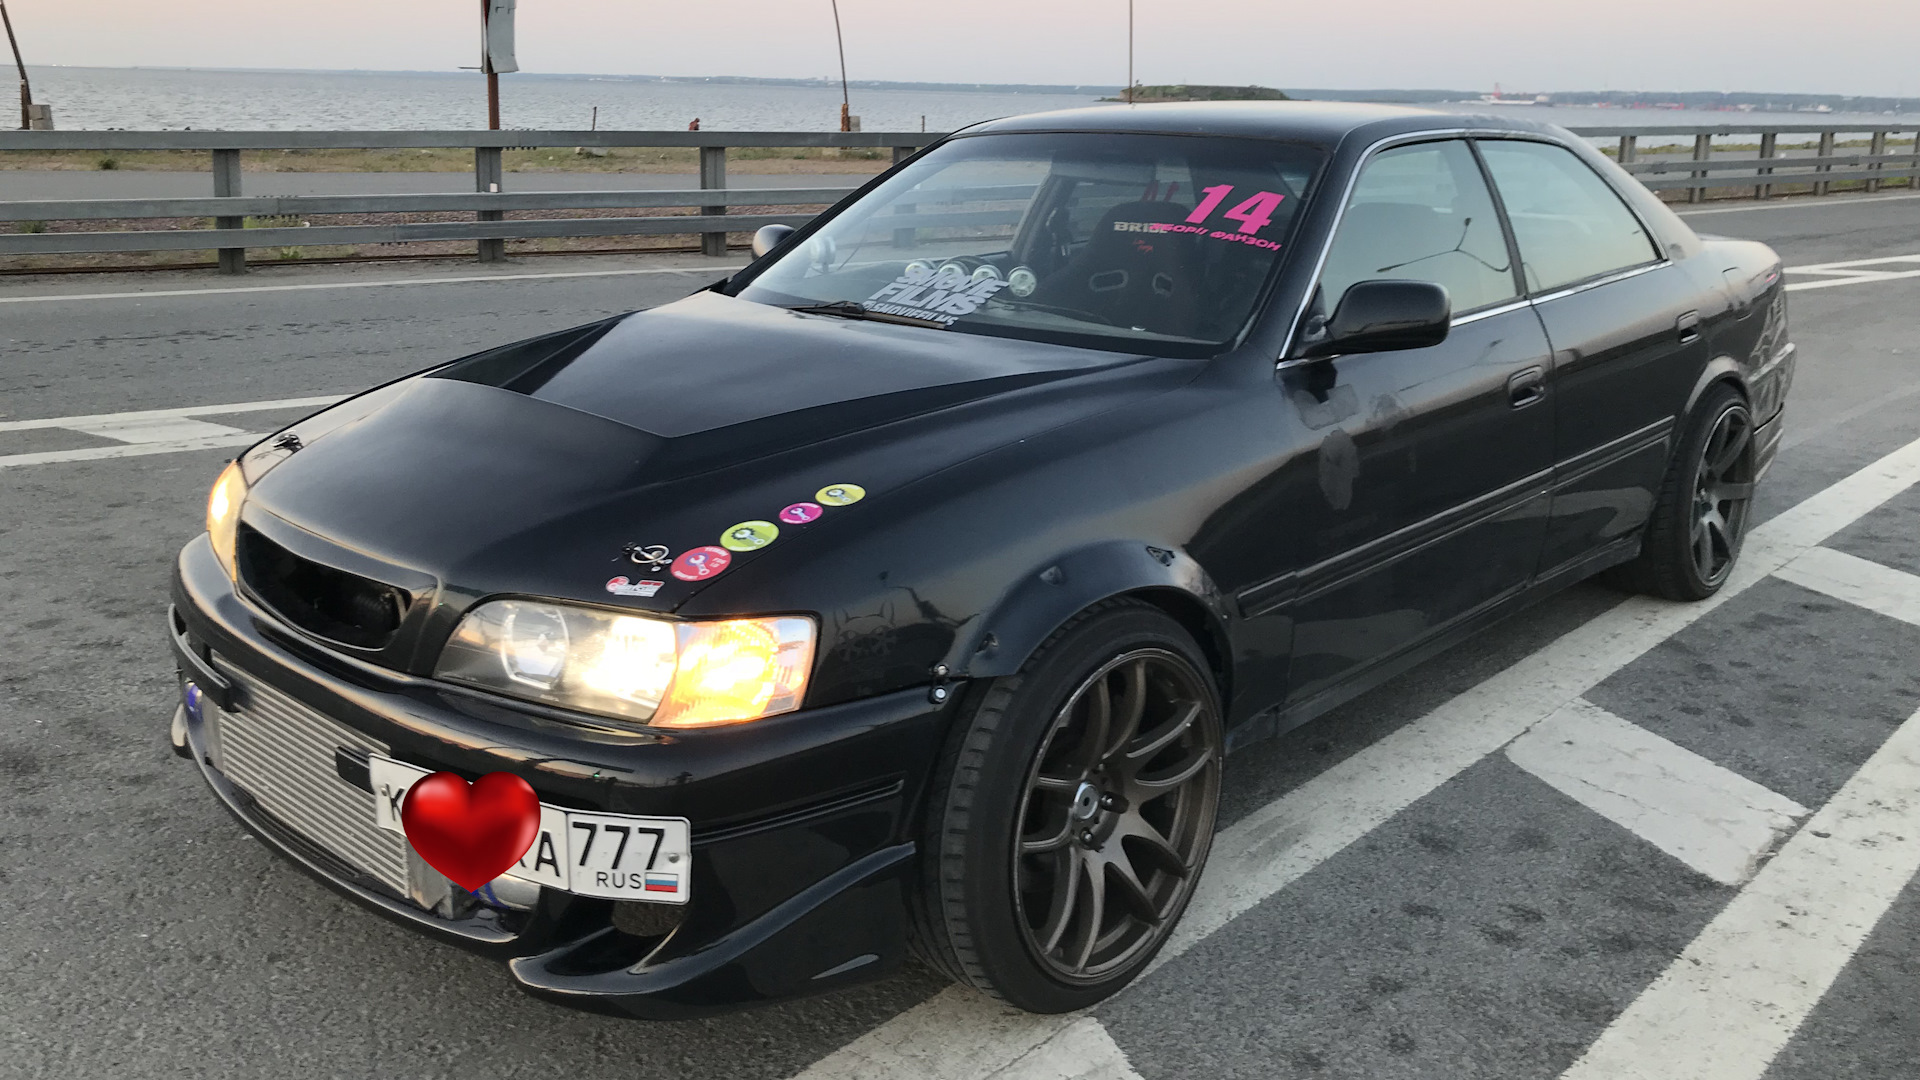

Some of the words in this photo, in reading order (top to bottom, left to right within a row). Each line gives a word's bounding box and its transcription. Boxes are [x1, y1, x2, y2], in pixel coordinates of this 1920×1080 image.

[1185, 184, 1285, 235] 14
[868, 282, 986, 316] FILMS
[571, 821, 665, 870] 777
[596, 871, 642, 889] RUS
